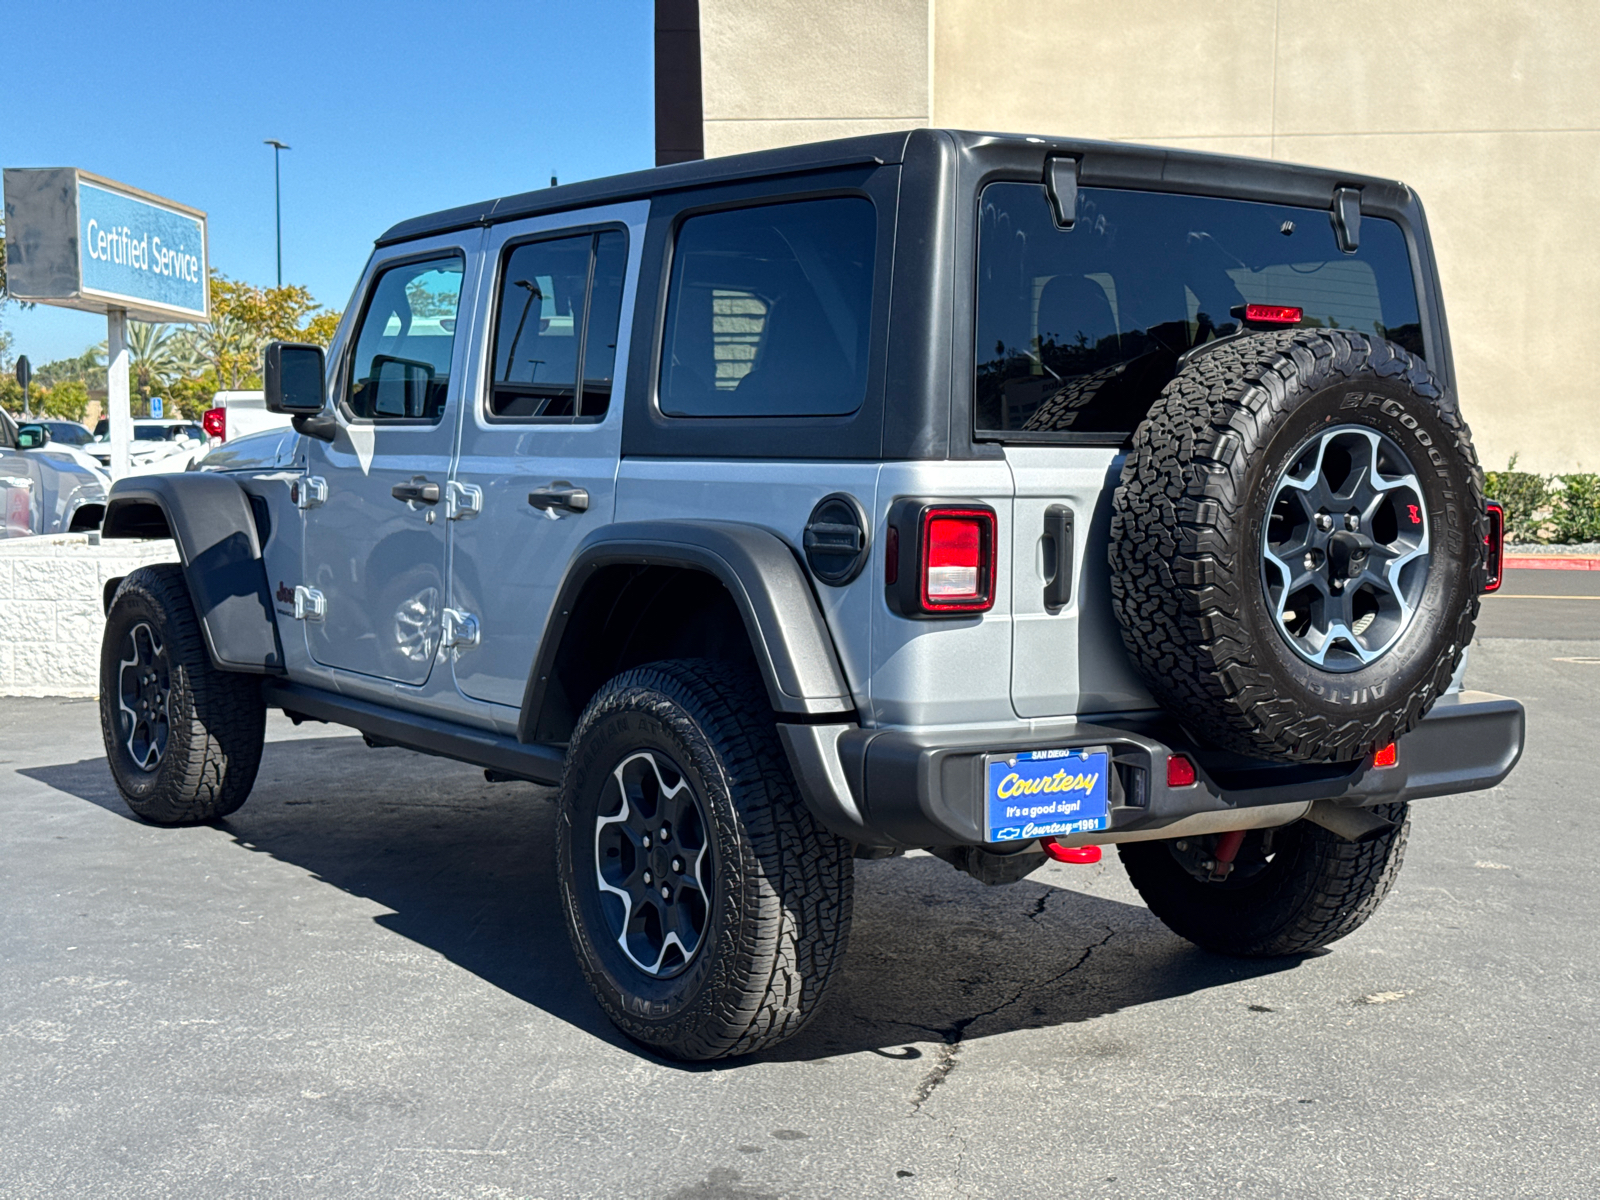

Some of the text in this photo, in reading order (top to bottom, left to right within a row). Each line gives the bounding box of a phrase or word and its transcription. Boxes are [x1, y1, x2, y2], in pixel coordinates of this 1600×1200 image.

[87, 218, 199, 284] Certified Service
[1339, 391, 1463, 555] BFGoodrich
[276, 581, 296, 608] Jee
[1031, 748, 1070, 760] SAN DIEGO
[996, 768, 1099, 799] Courtesy
[1006, 800, 1081, 818] It's a good sign!
[1022, 822, 1073, 838] Courtesy
[1078, 818, 1099, 831] 1961
